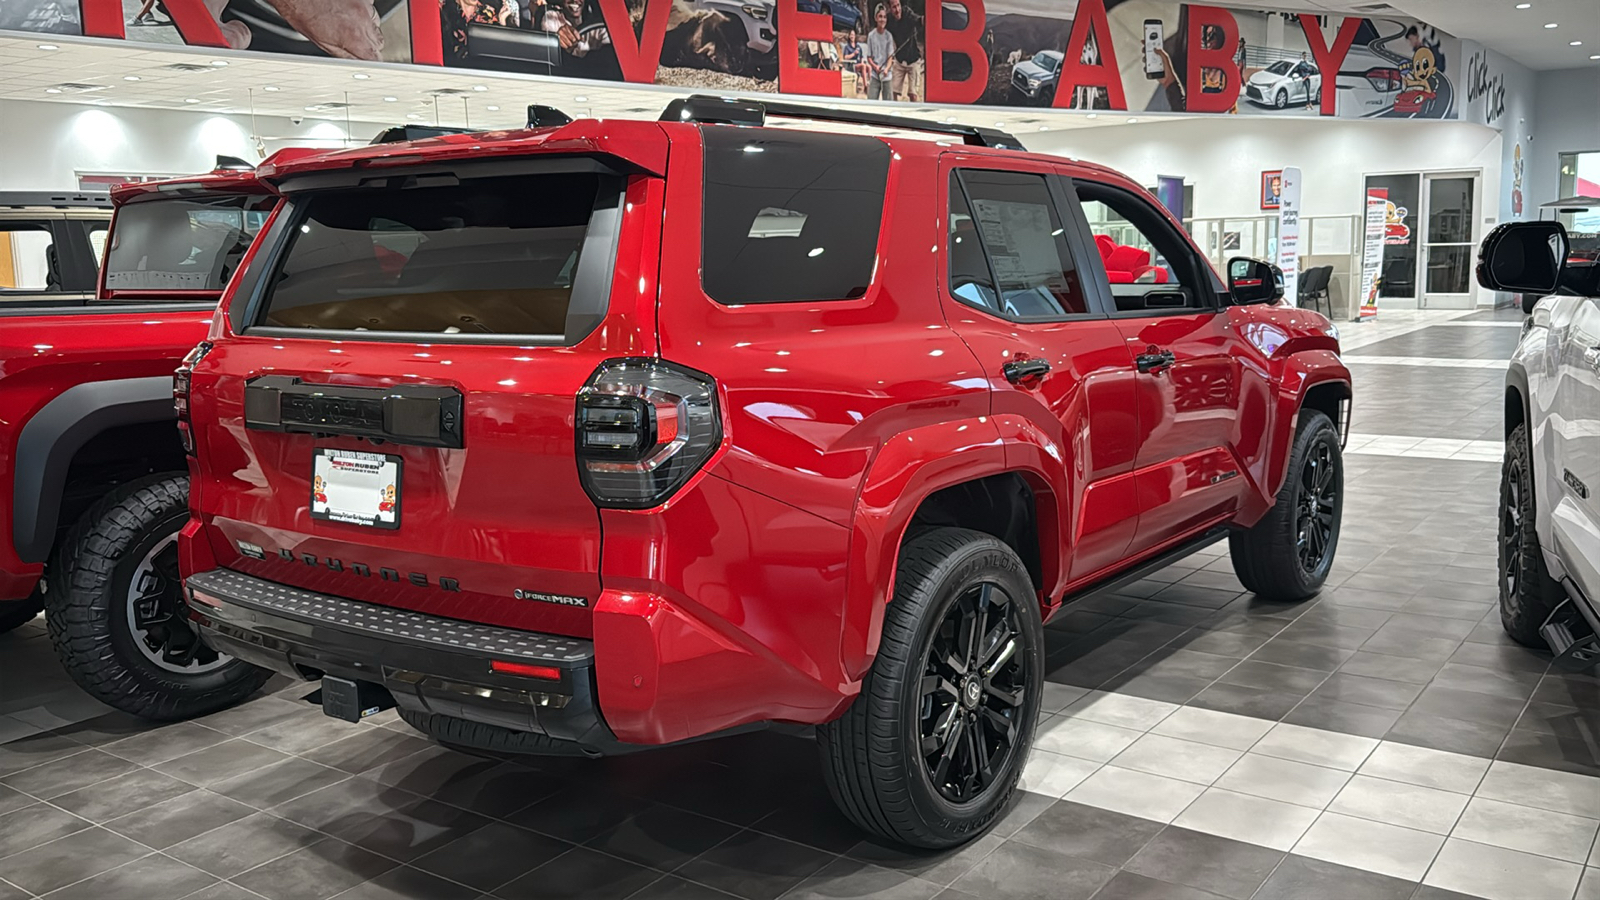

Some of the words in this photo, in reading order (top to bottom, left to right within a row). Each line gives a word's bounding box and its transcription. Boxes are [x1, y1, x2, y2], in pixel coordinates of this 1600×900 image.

[1467, 50, 1488, 103] Click
[1485, 73, 1506, 124] Click
[355, 462, 379, 470] RUBEN
[278, 547, 462, 593] 4RUNNER
